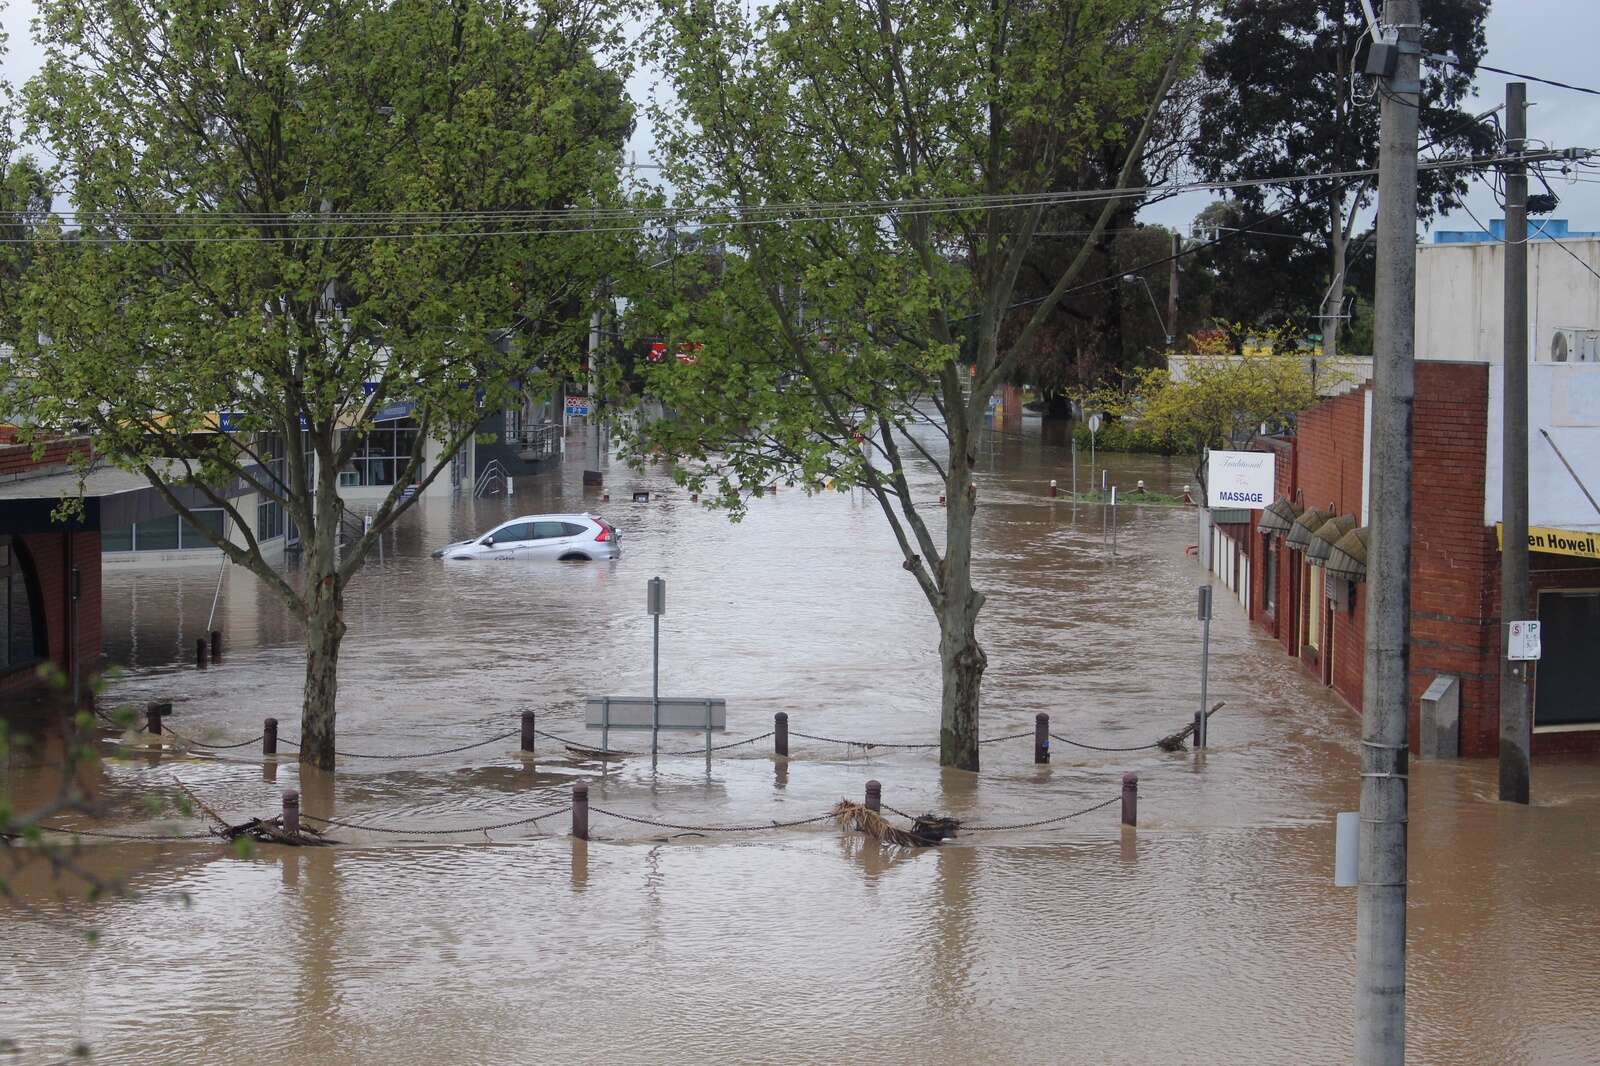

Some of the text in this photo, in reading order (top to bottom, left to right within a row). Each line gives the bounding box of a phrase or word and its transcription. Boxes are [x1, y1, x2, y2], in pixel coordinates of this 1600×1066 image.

[1219, 491, 1263, 502] MASSAGE
[1547, 534, 1595, 552] Howell
[1528, 623, 1538, 632] 1P
